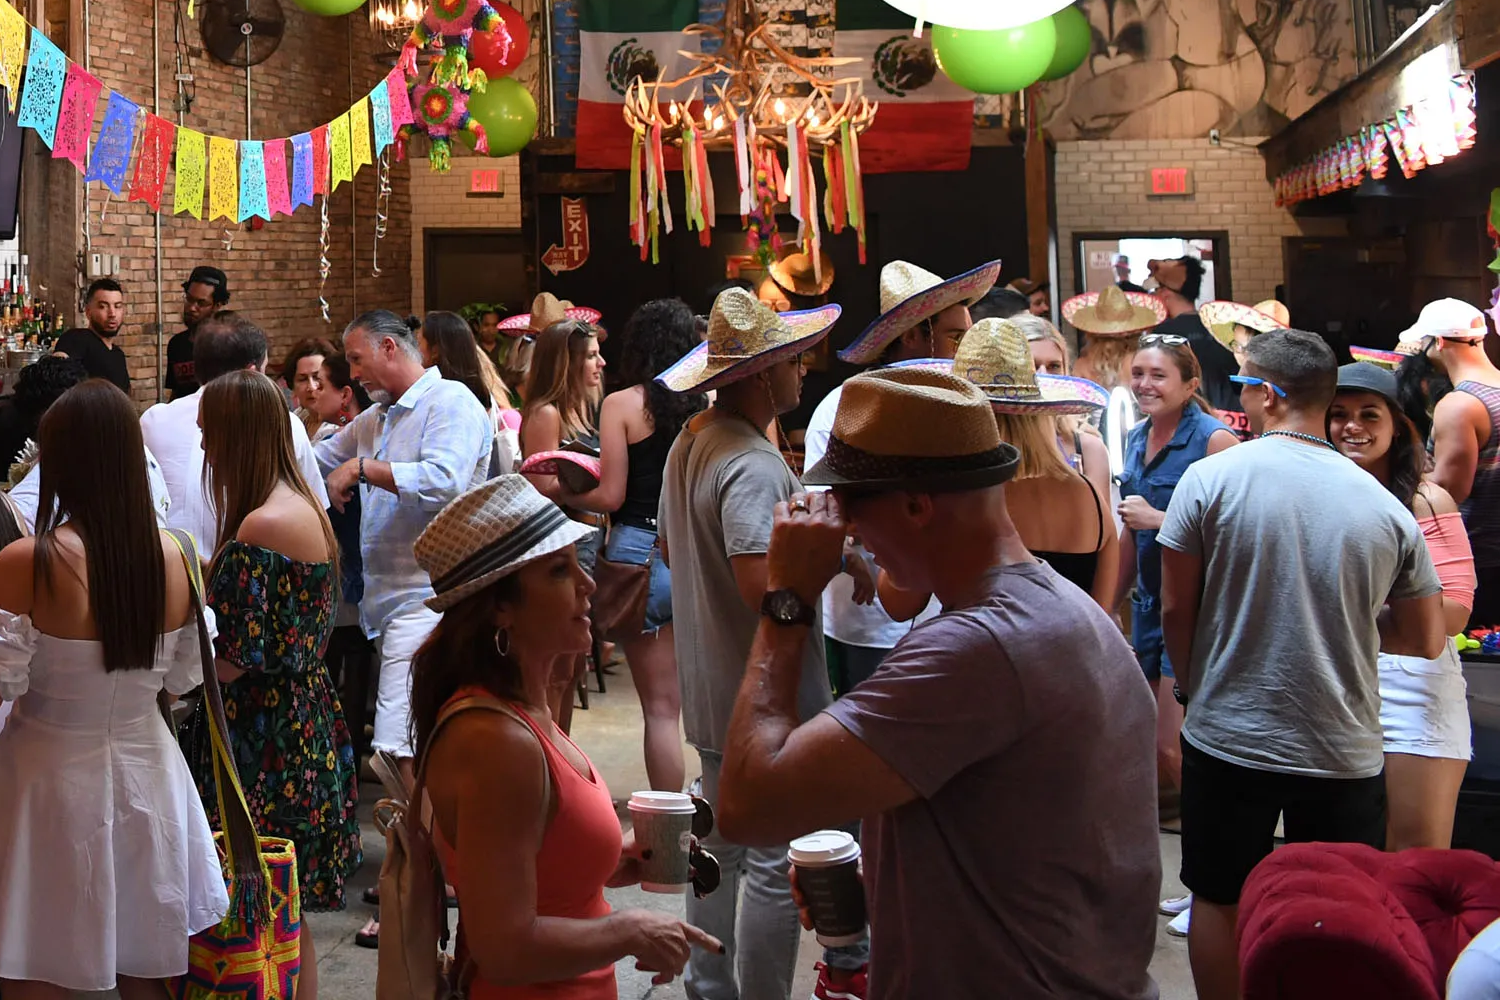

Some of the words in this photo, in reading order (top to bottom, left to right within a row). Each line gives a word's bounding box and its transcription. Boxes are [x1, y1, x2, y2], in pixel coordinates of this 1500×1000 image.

[471, 169, 499, 192] EXIT
[1151, 168, 1187, 193] EXIT
[566, 204, 584, 261] EXIT
